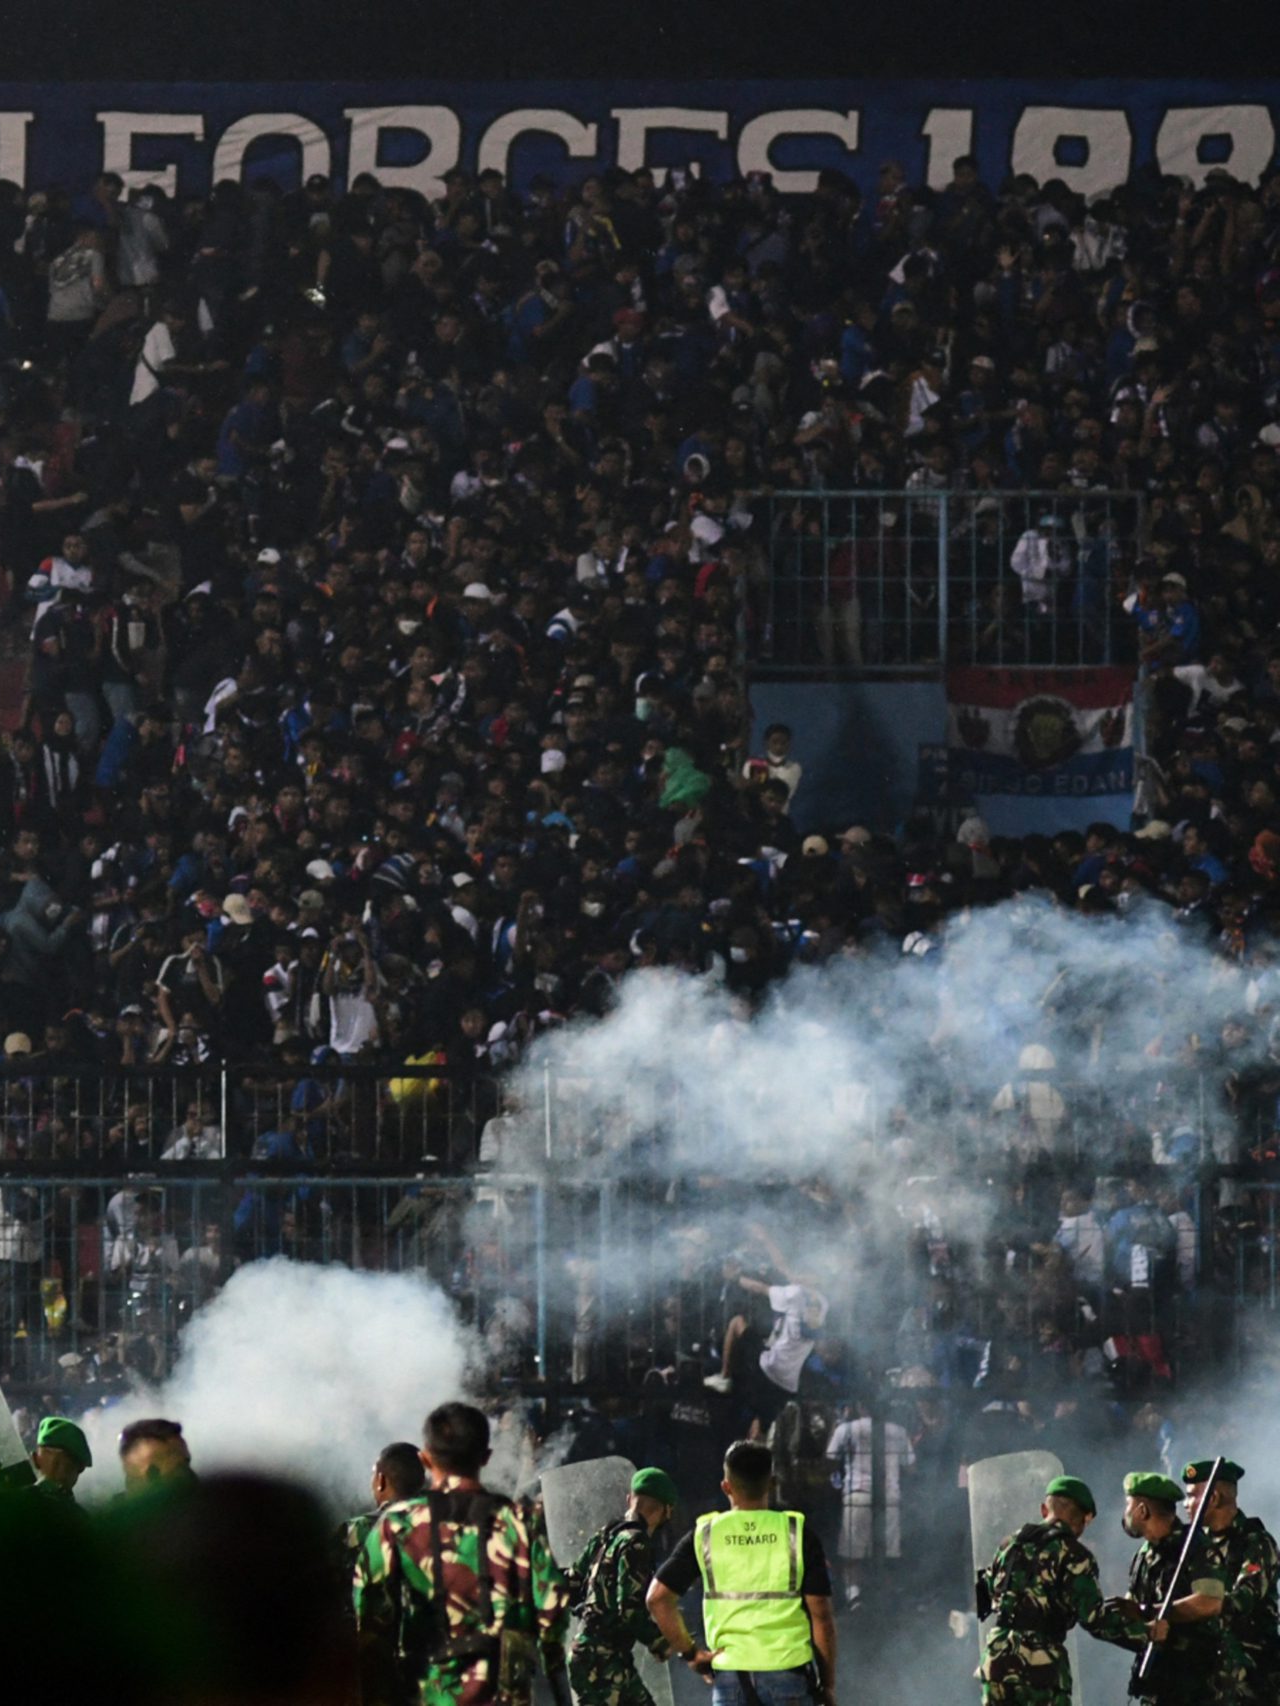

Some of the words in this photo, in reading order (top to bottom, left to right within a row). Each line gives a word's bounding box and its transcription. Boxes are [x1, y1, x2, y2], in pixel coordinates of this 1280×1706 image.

[96, 104, 859, 205] FORCES
[743, 1521, 757, 1532] 35
[724, 1533, 778, 1546] STEWARD
